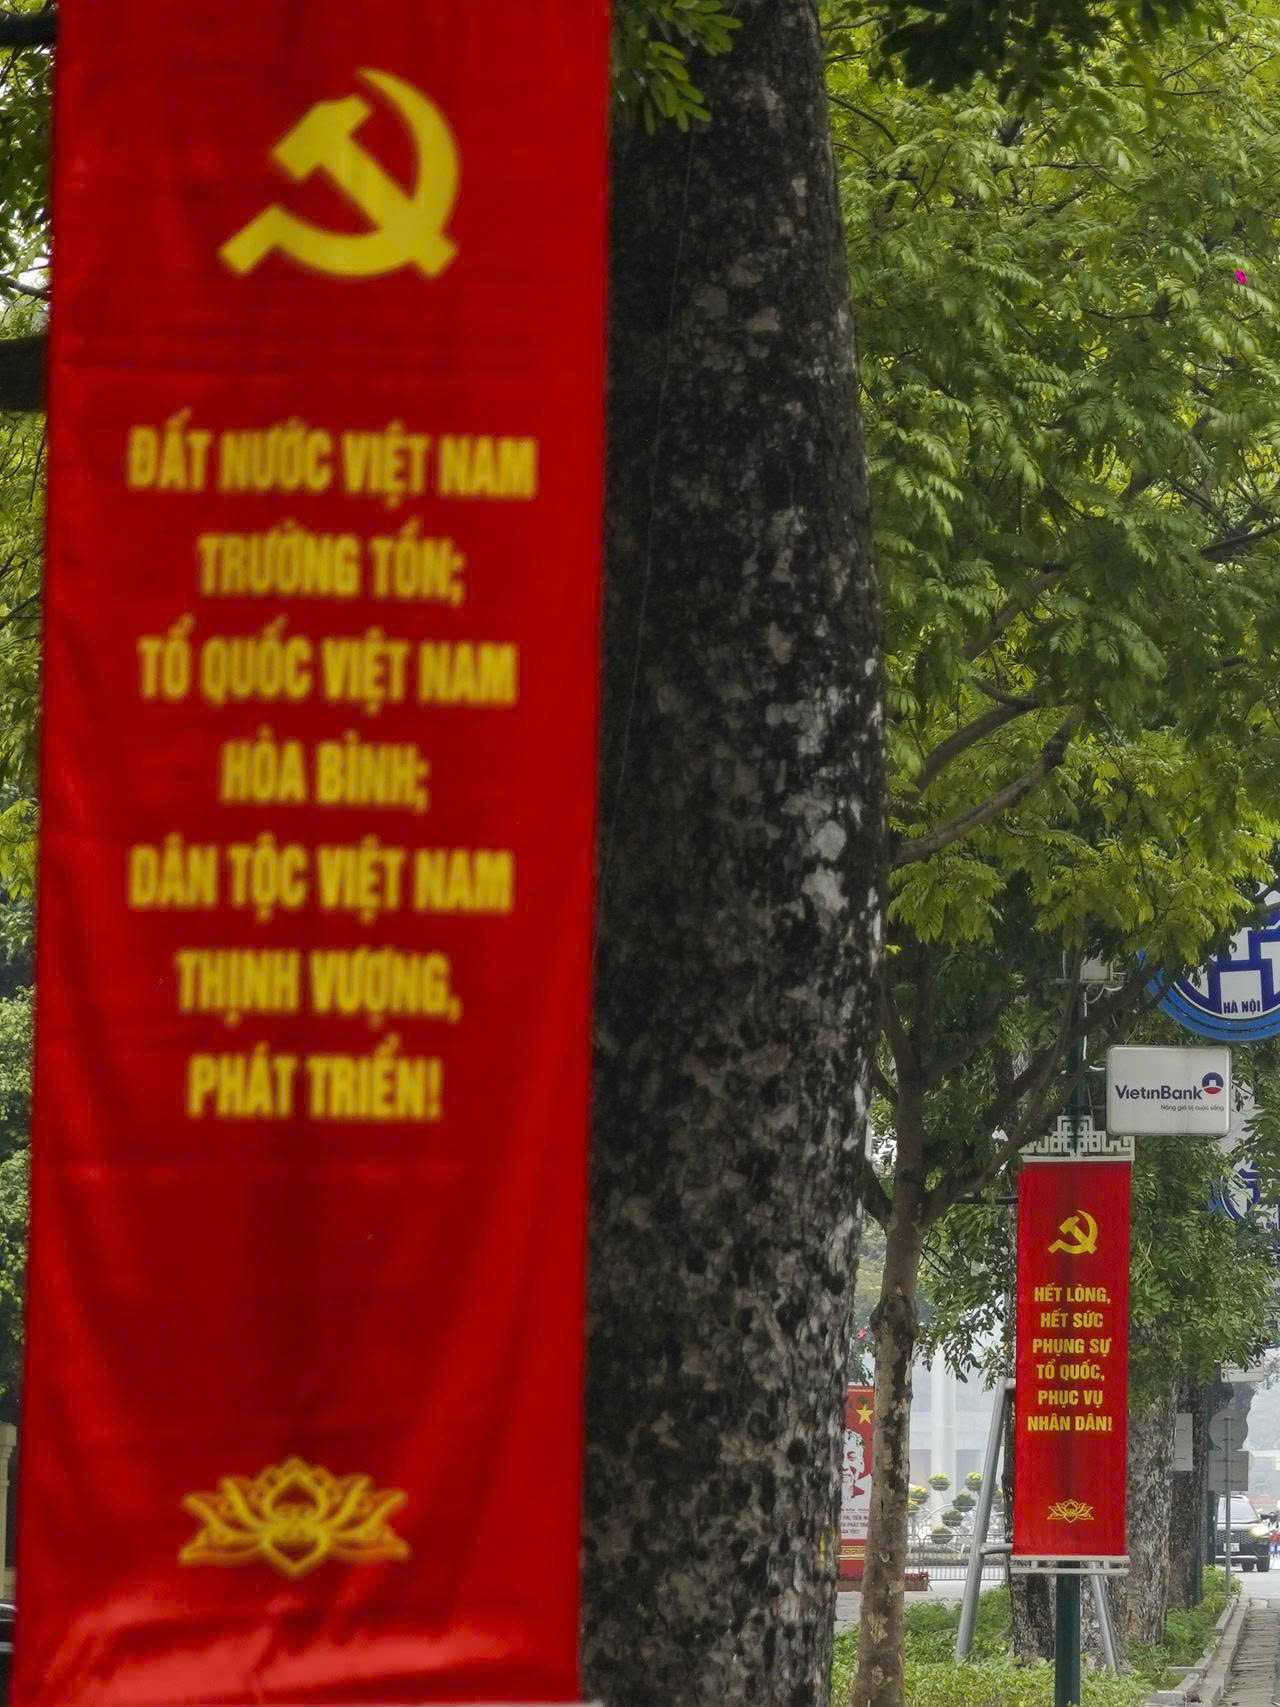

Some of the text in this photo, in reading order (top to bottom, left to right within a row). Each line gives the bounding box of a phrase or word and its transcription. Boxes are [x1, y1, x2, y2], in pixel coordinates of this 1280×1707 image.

[219, 418, 333, 492] NƯỚC
[341, 421, 430, 508] VIỆT
[438, 435, 537, 499] NAM
[200, 614, 313, 705] QUỐC
[321, 626, 410, 715] VIỆT
[419, 641, 517, 705] NAM
[221, 726, 308, 803] HÒA
[129, 831, 513, 924] DÂN TỘC VIỆT NAM
[176, 948, 300, 1025] THỊNH
[1241, 998, 1261, 1015] NỘI
[188, 1042, 298, 1118] PHÁT
[1115, 1085, 1203, 1100] VietinBank
[1034, 1282, 1111, 1304] HẾT LÒNG,
[1040, 1308, 1104, 1329] HẾT SỨC
[1032, 1337, 1112, 1357] PHỤNG SỰ
[1036, 1358, 1105, 1381] TỔ QUỐC,
[1038, 1389, 1104, 1408] PHỤC VỤ
[1027, 1412, 1113, 1431] NHÂN DÂN!
